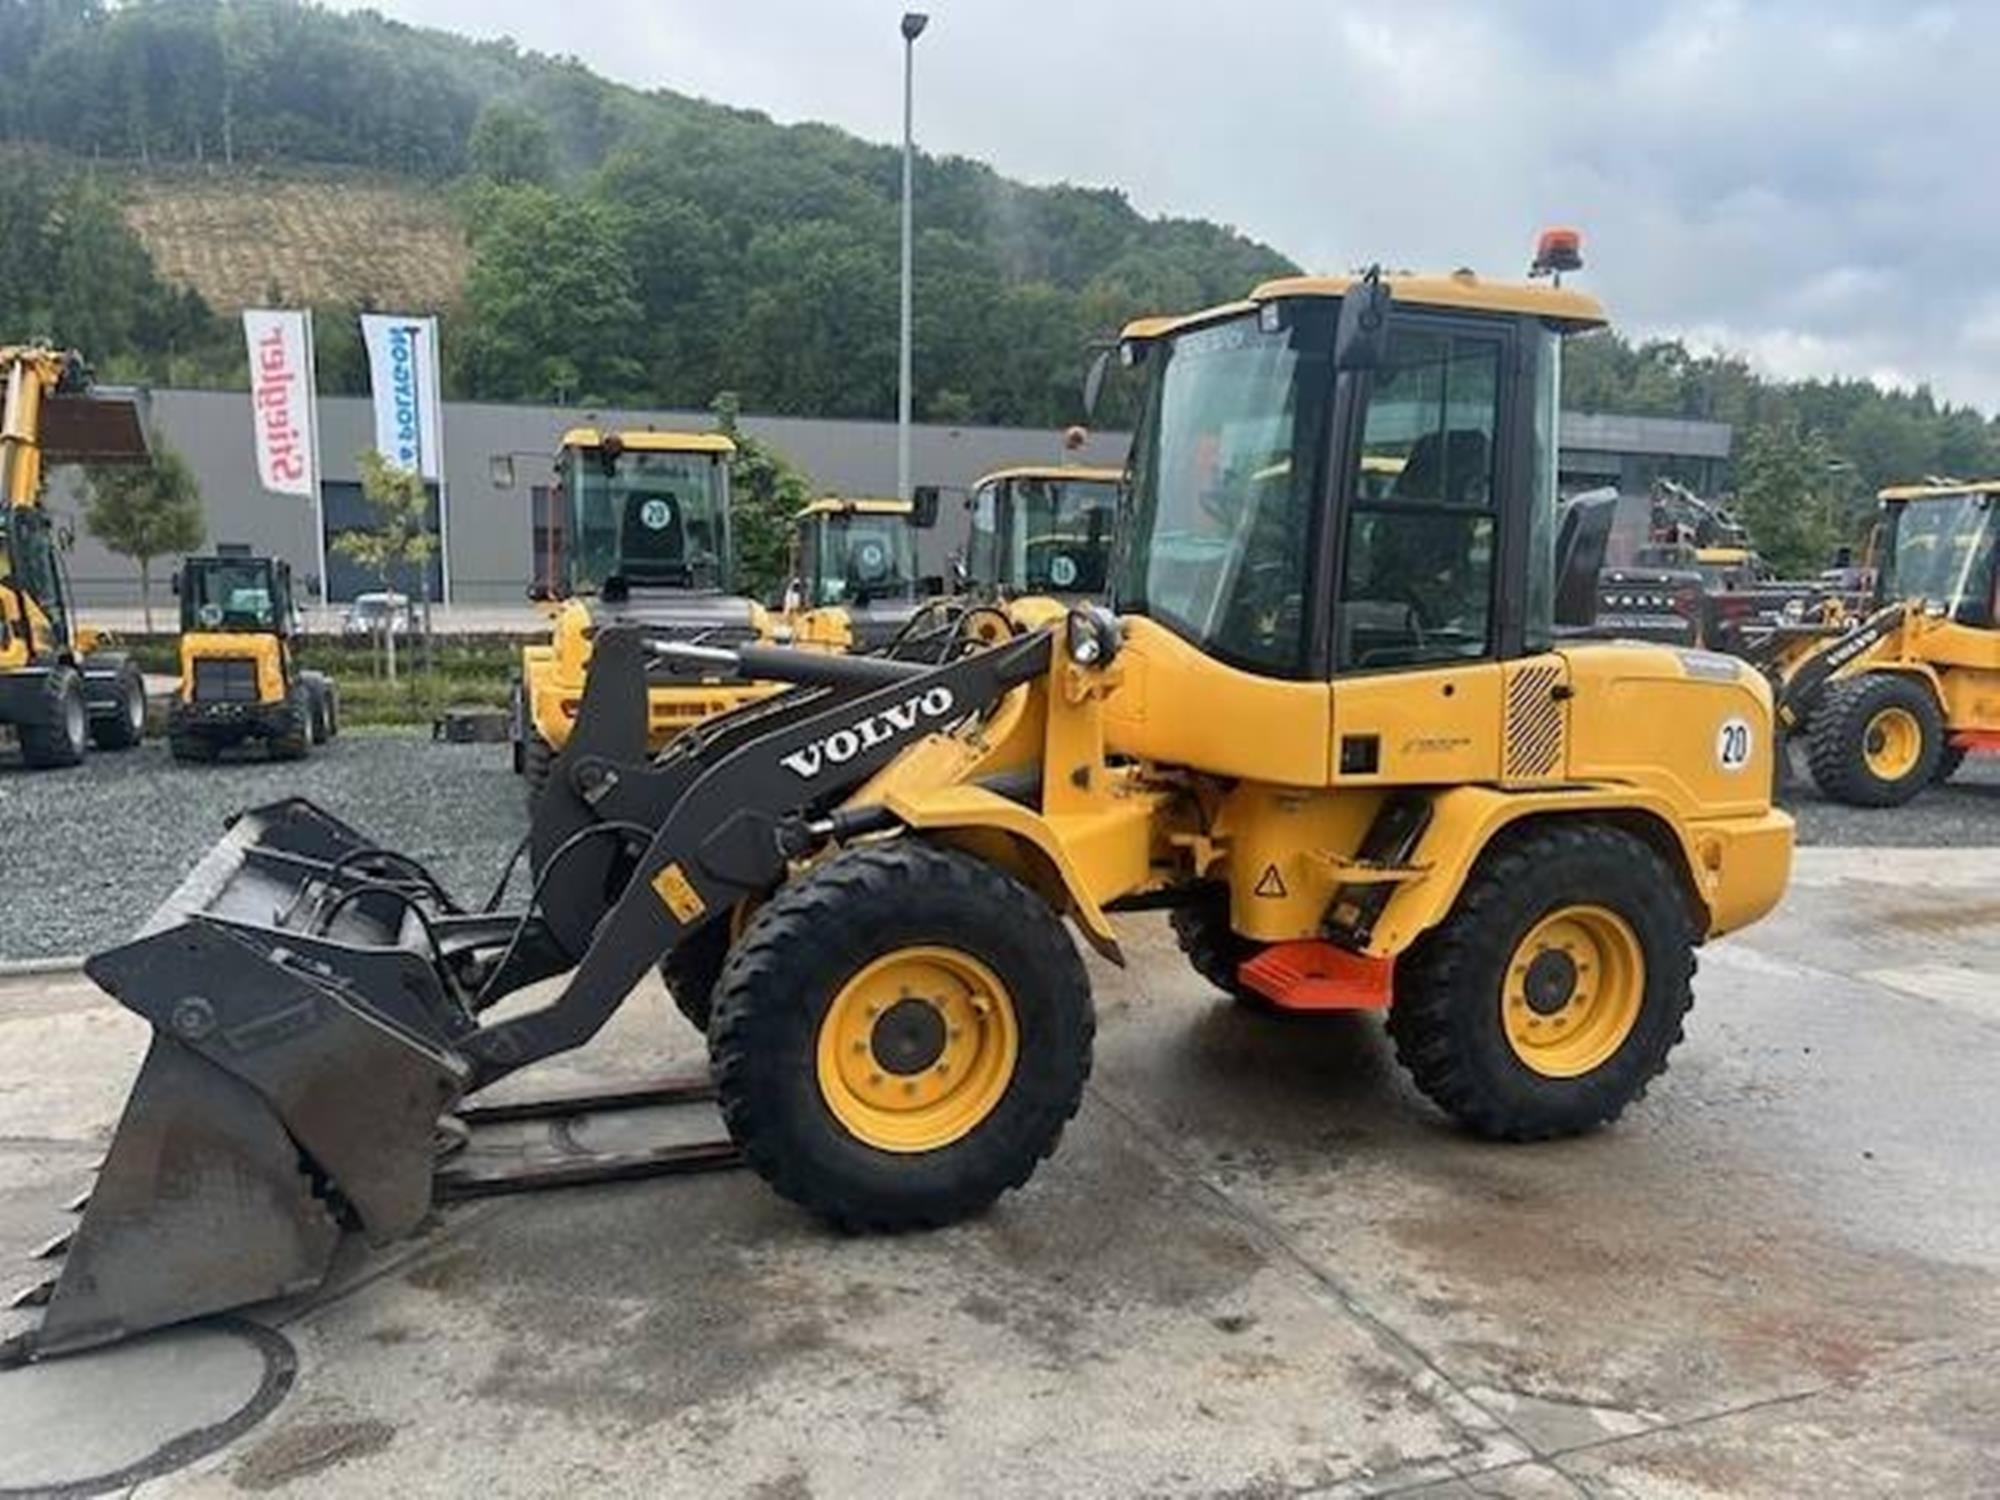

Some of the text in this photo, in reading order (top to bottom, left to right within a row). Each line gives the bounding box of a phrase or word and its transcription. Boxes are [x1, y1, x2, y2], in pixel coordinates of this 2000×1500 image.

[648, 503, 666, 523] 20
[780, 686, 953, 777] VOLVO
[1723, 726, 1747, 763] 20
